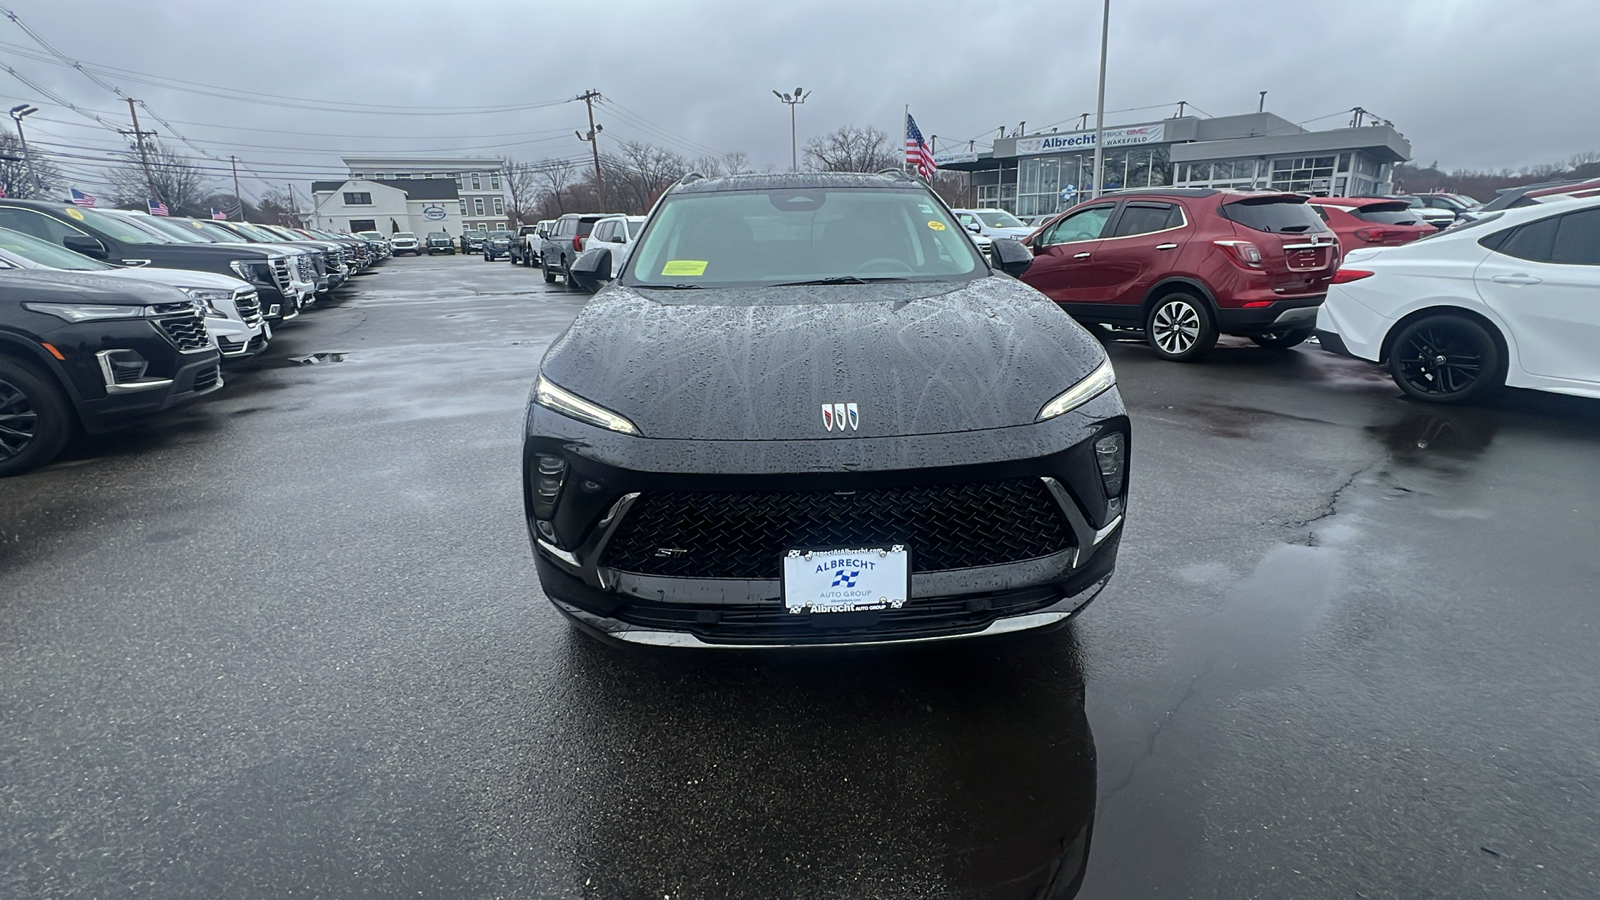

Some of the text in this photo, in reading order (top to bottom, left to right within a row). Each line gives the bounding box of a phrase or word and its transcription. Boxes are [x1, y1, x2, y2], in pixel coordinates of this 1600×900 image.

[1043, 134, 1096, 148] Albrecht
[1107, 137, 1147, 146] WAKEFIELD
[815, 559, 875, 574] ALBRECHT
[843, 590, 872, 598] GROUP
[810, 602, 855, 613] Albrecht
